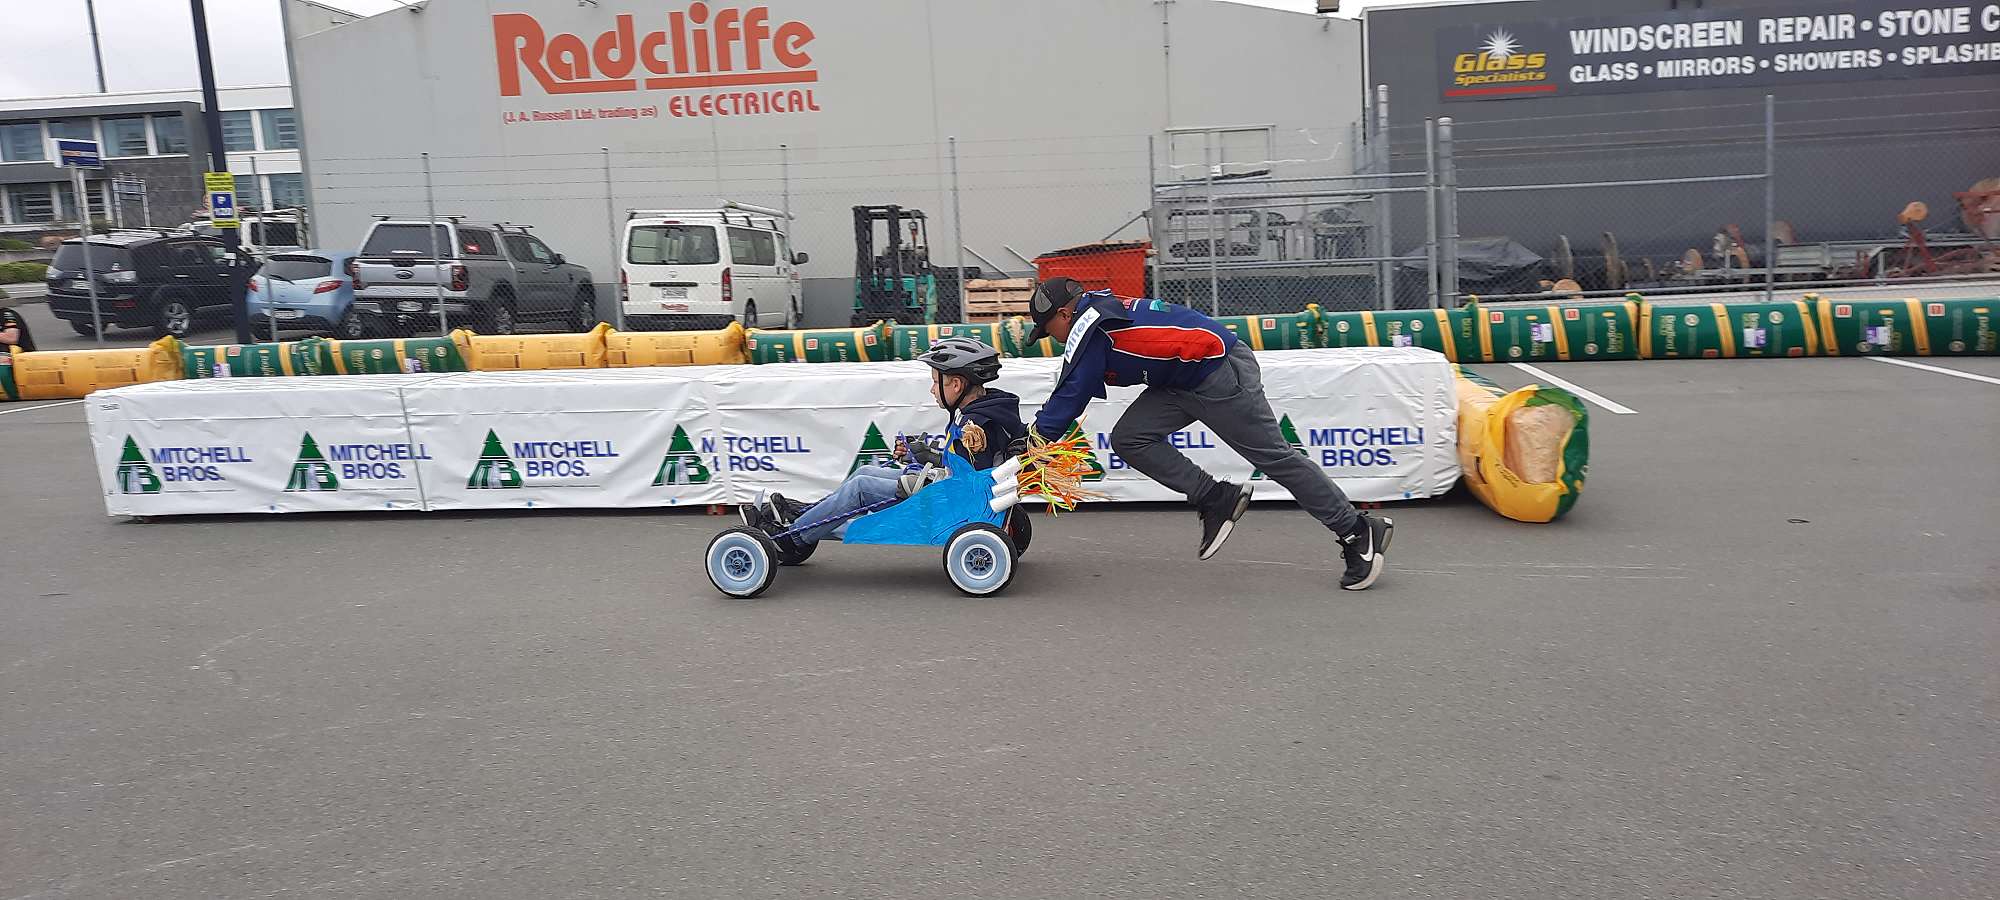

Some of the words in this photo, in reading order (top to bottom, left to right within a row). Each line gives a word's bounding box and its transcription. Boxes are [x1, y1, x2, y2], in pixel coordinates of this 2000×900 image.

[1569, 20, 1744, 55] WINDSCREEN
[1758, 14, 1856, 44] REPAIR
[1878, 7, 1971, 38] STONE
[492, 2, 817, 97] Radcliffe
[1454, 52, 1547, 73] Glass
[1569, 62, 1639, 83] GLASS
[1657, 55, 1756, 78] MIRRORS
[1773, 49, 1883, 72] SHOWERS
[1454, 71, 1547, 87] Specialists
[532, 109, 573, 122] Russell
[598, 106, 639, 120] trading
[640, 105, 658, 118] as)
[668, 90, 820, 118] ELECTRICAL
[149, 446, 253, 464] MITCHELL
[328, 443, 433, 462] MITCHELL
[513, 440, 620, 459] MITCHELL
[1322, 448, 1398, 467] BROS.
[162, 465, 226, 482] BROS.
[342, 462, 407, 480] BROS.
[525, 460, 591, 478] BROS.
